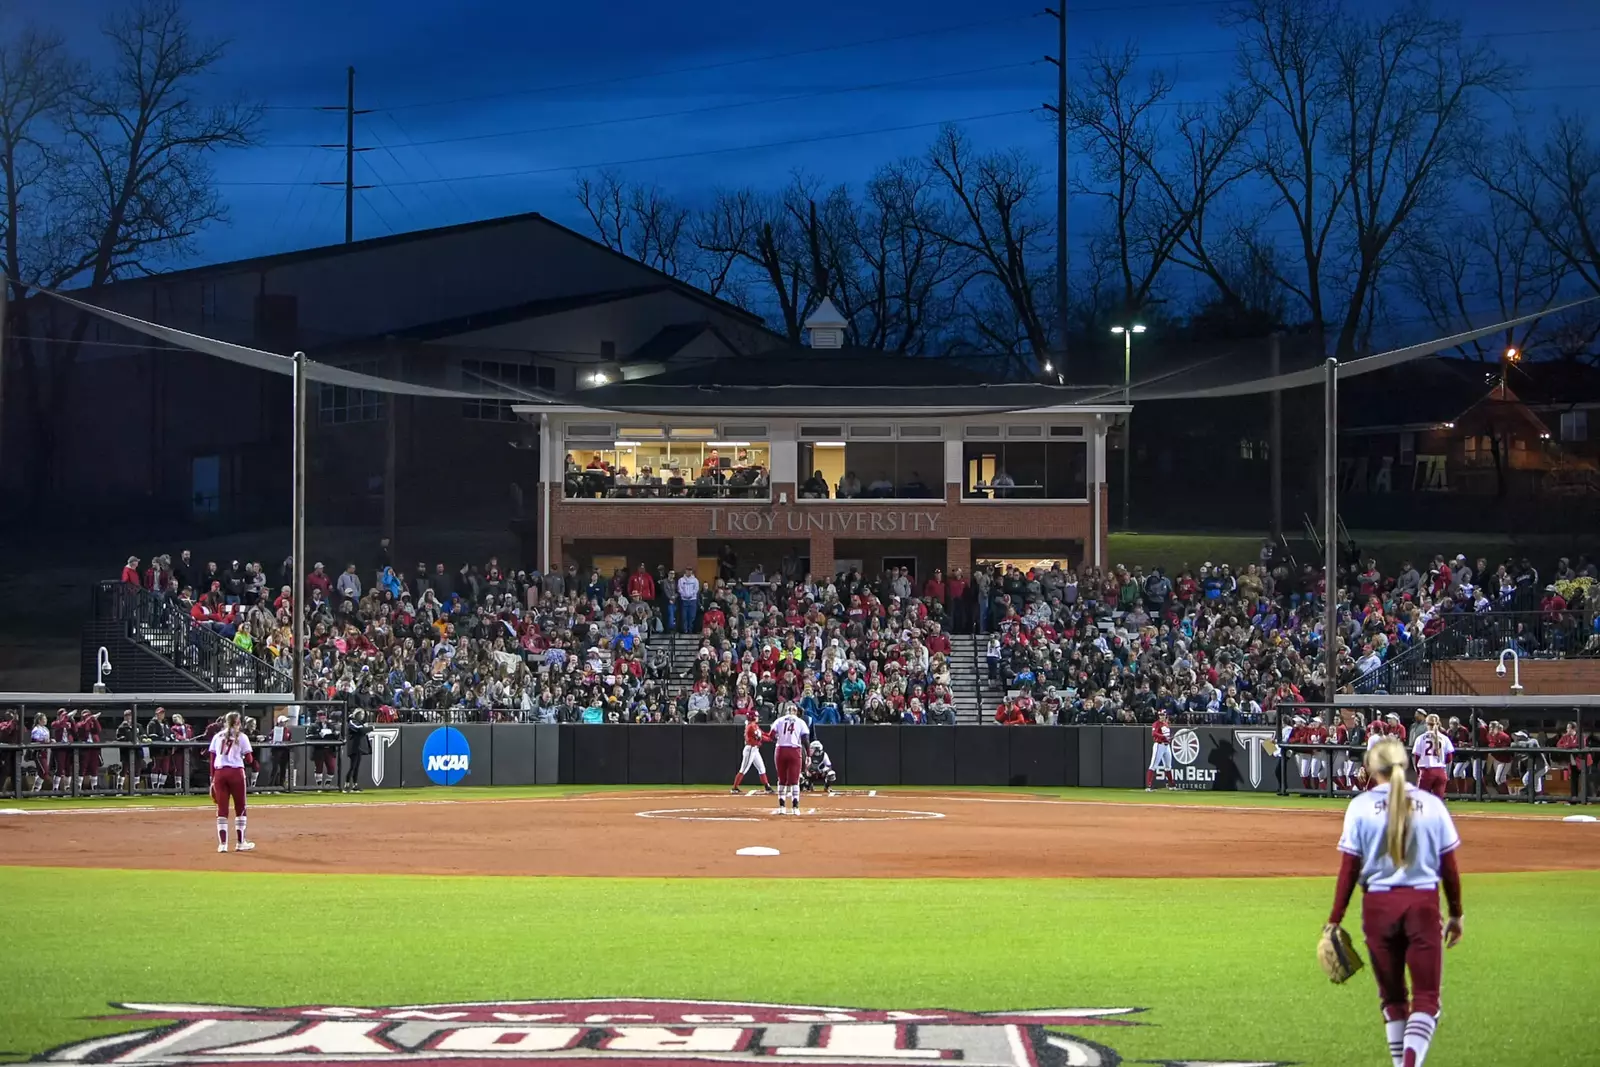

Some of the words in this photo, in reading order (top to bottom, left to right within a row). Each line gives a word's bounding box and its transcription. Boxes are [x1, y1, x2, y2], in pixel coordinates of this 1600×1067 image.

[705, 507, 778, 531] TROY
[787, 511, 941, 531] UNIVERSITY
[783, 722, 795, 735] 14
[427, 754, 468, 771] NCAA
[1186, 766, 1218, 781] BELT
[198, 1020, 950, 1058] TROY
